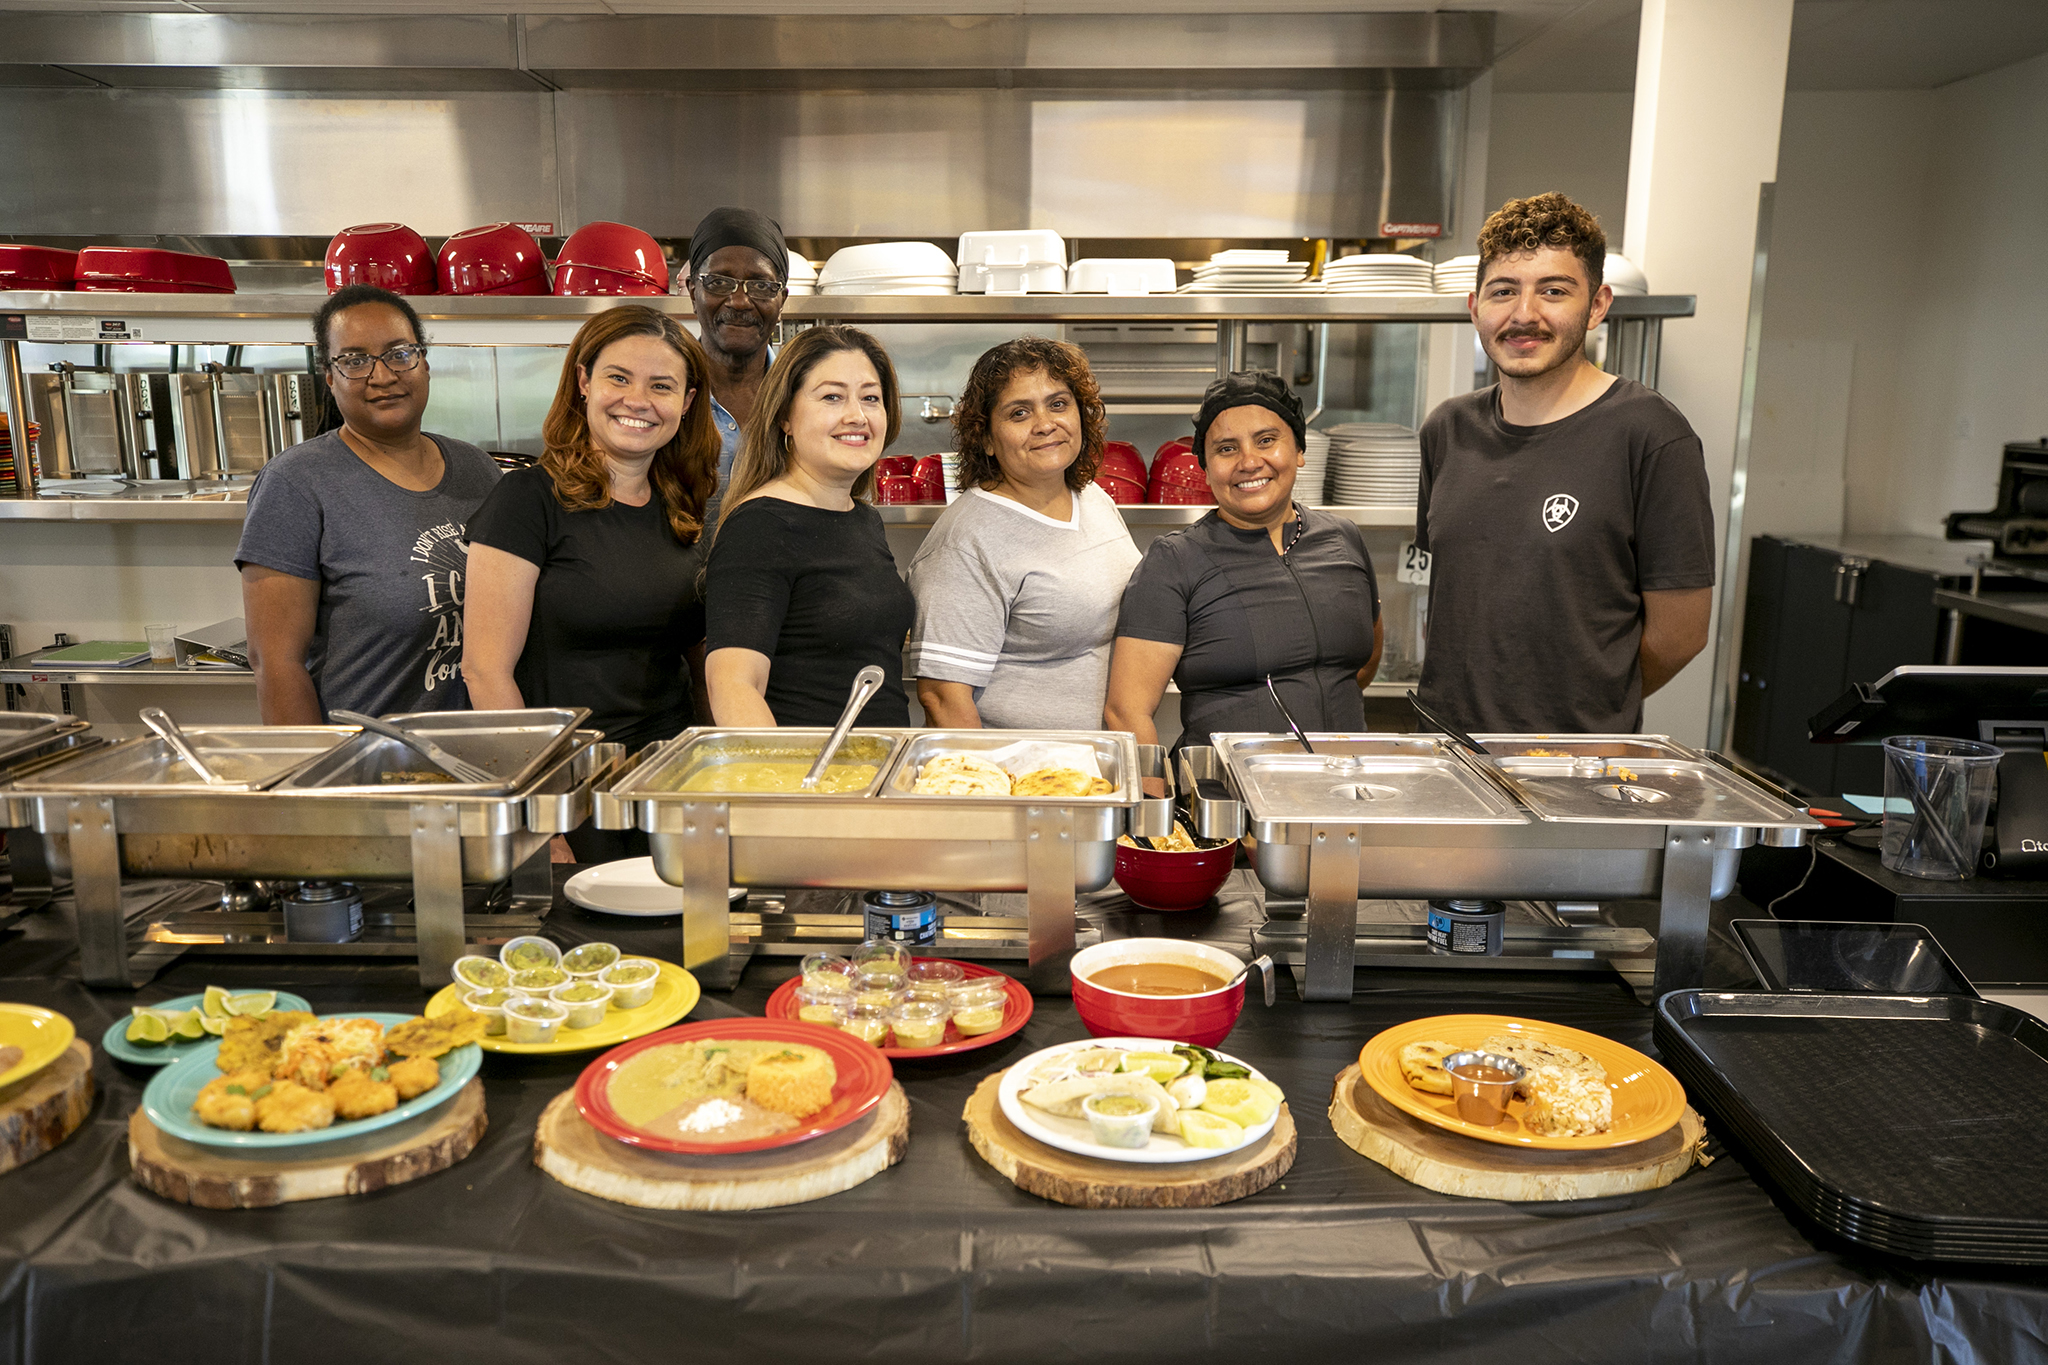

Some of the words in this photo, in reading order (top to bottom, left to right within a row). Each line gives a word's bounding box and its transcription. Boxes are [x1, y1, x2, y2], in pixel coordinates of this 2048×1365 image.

[515, 224, 552, 233] VEAIRE
[430, 523, 460, 540] RISE
[1406, 544, 1429, 571] 25
